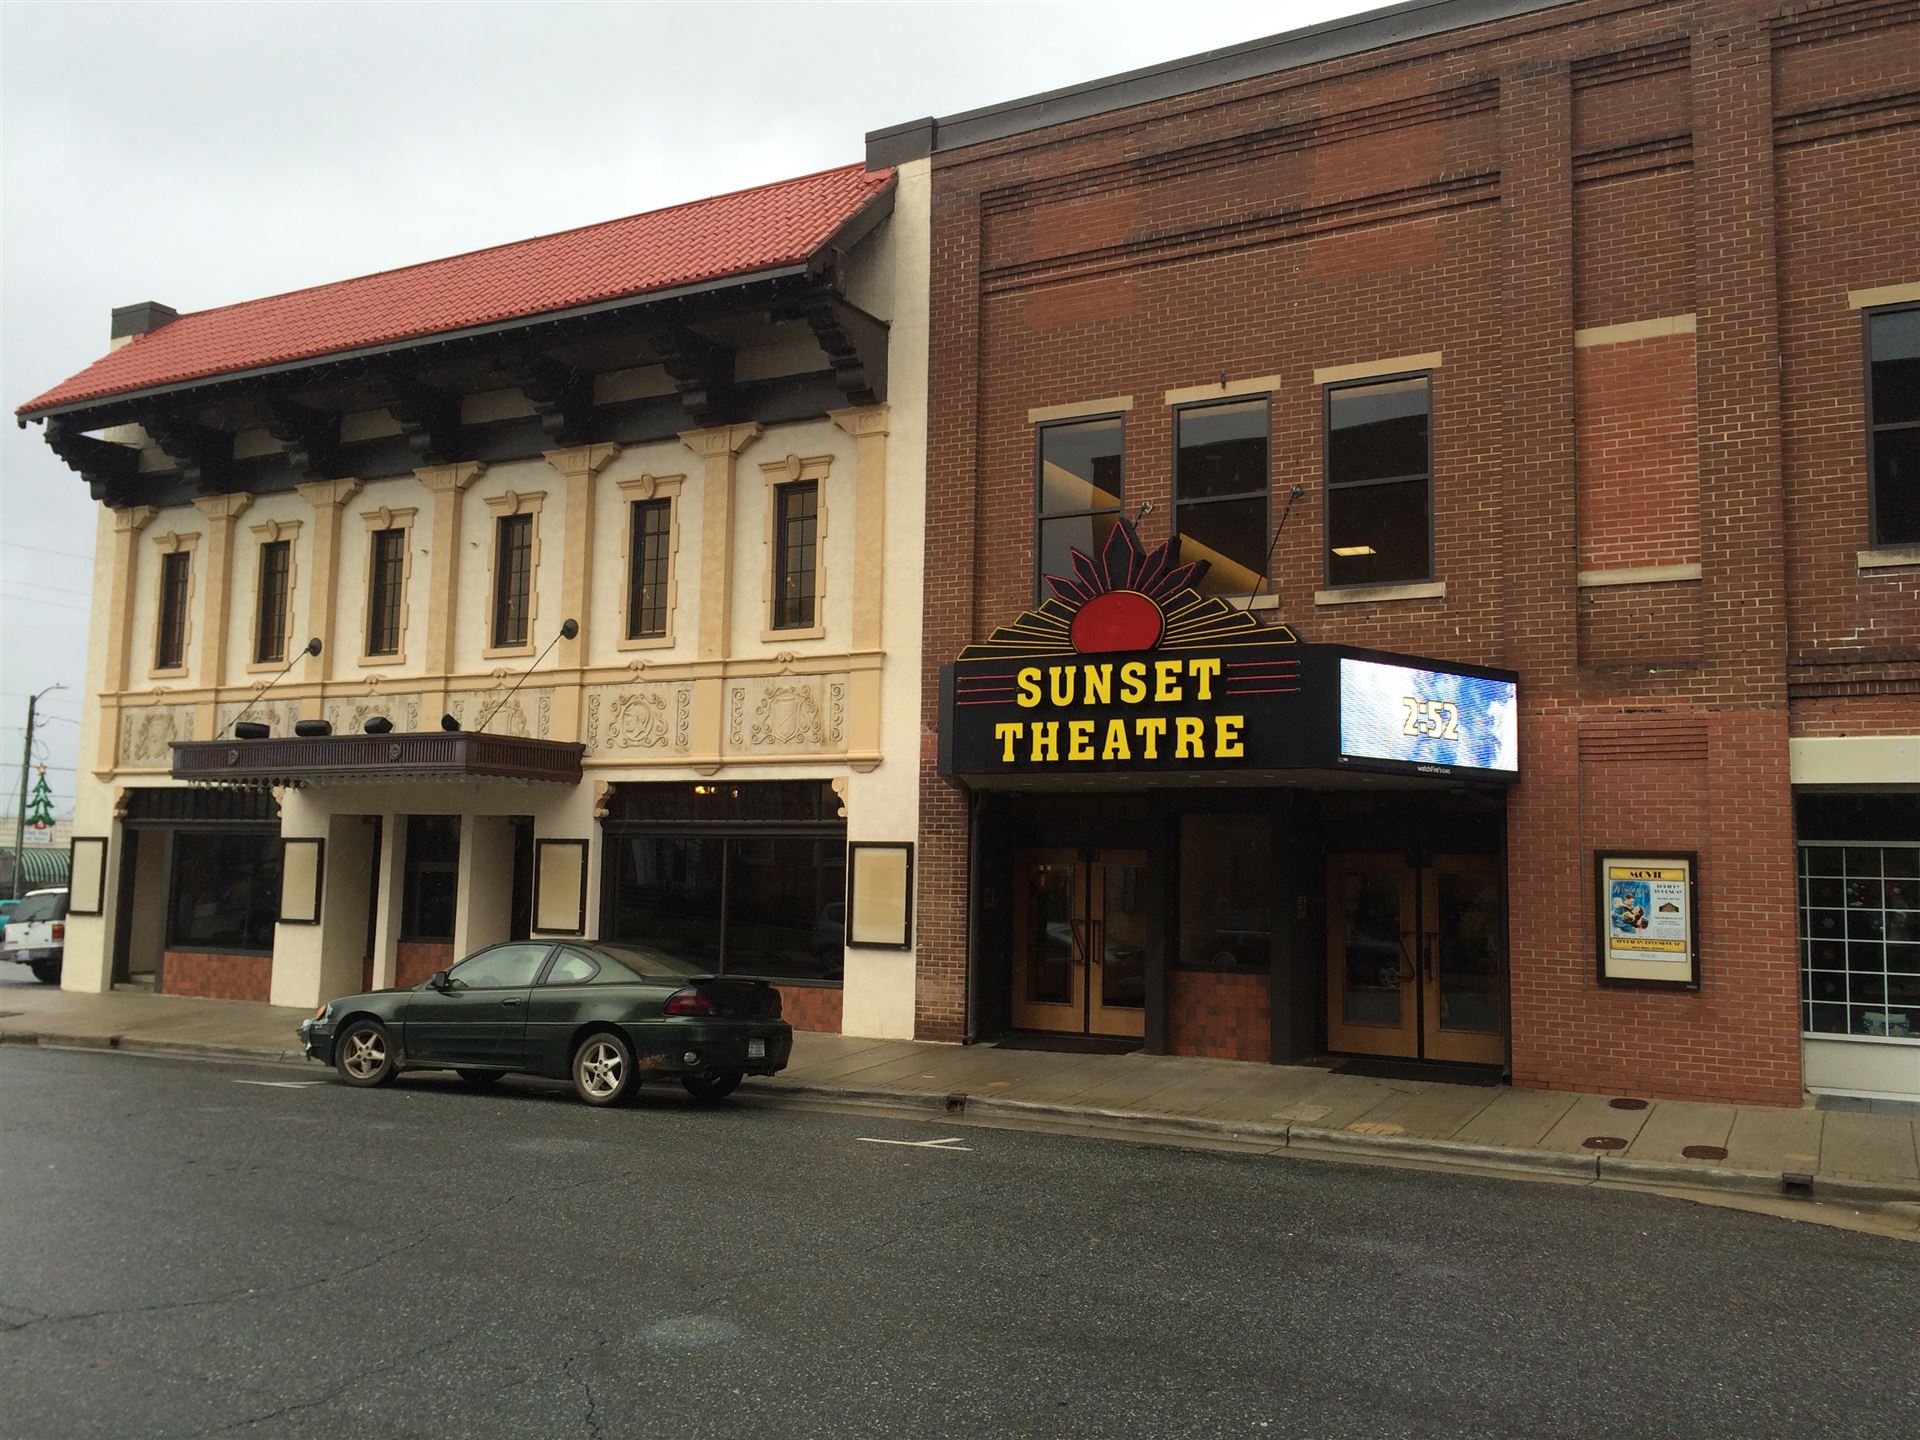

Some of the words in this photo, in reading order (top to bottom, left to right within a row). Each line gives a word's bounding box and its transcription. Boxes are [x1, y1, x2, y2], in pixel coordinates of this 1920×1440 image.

[1016, 657, 1221, 708] SUNSET
[995, 715, 1245, 763] THEATRE
[1403, 696, 1459, 741] 2:52
